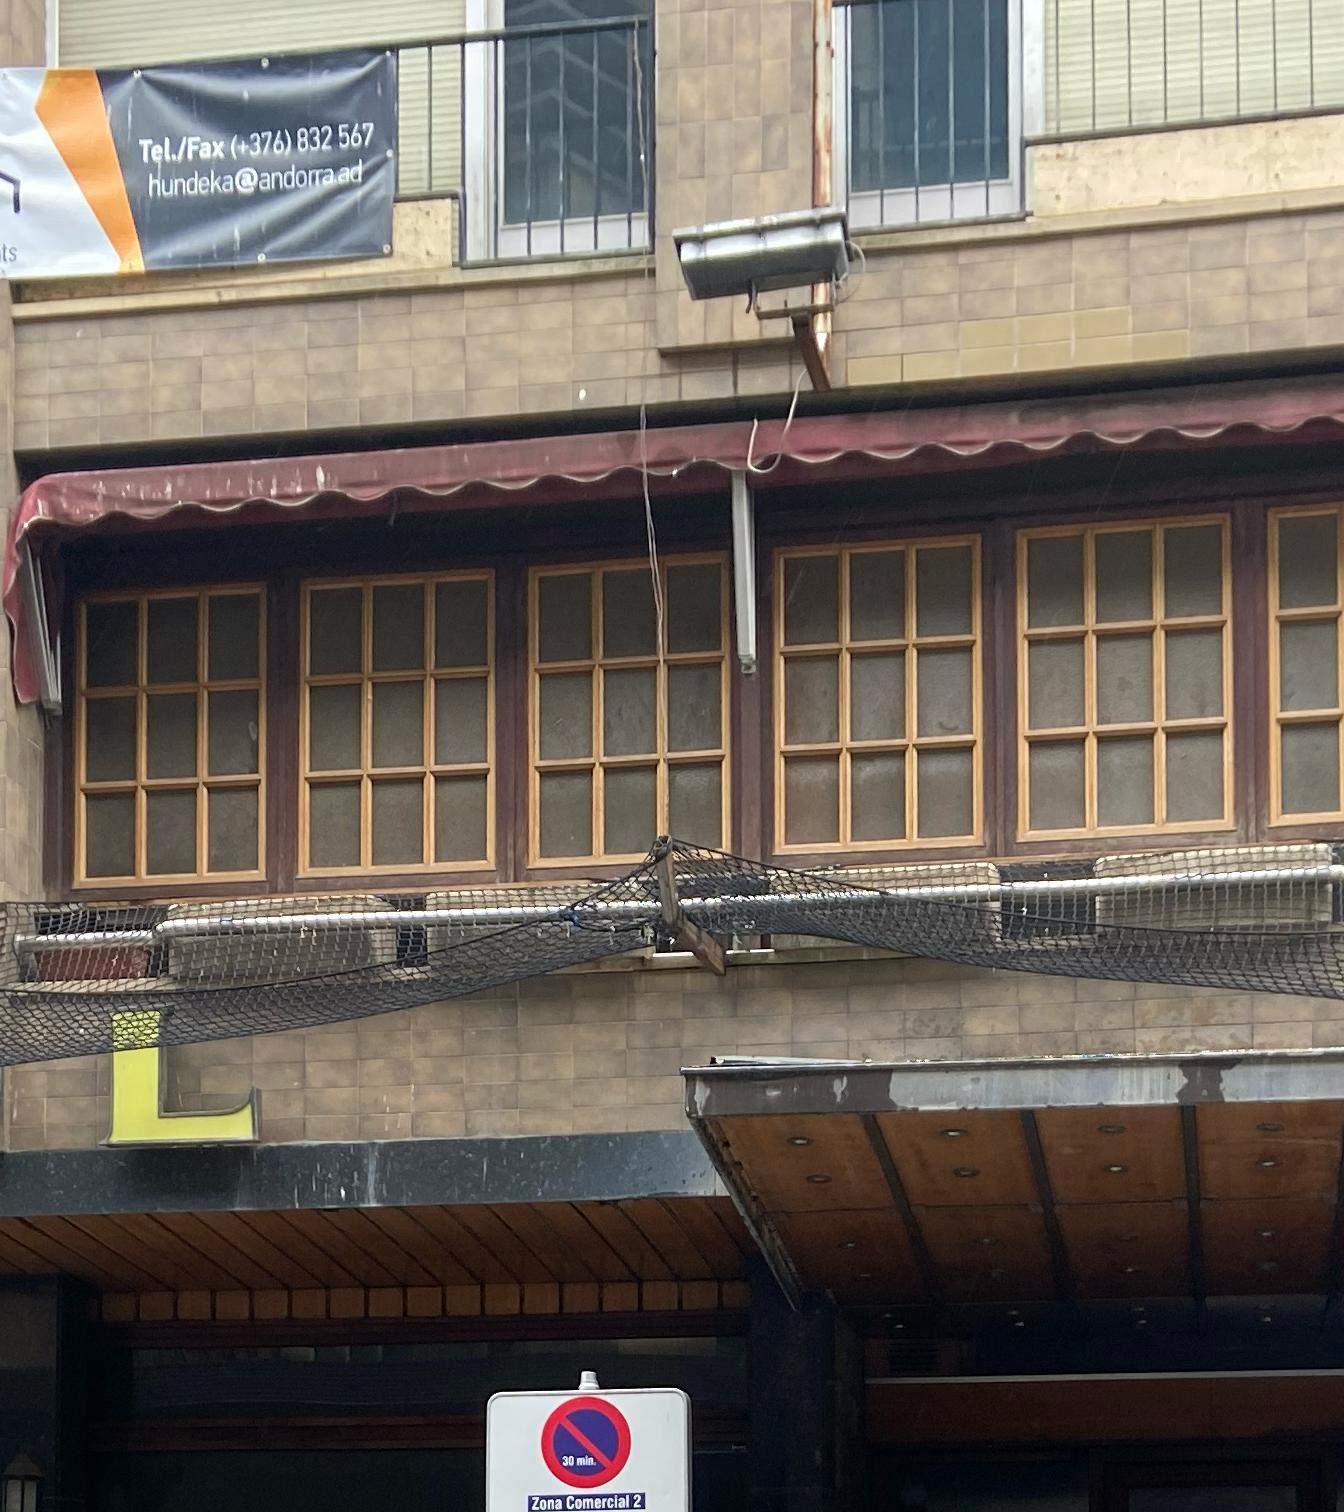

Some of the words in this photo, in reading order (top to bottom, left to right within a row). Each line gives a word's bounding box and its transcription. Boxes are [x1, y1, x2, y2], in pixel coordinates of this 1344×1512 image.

[138, 136, 225, 163] Tel./Fax
[230, 129, 292, 160] (+376)
[296, 125, 333, 152] 832
[338, 122, 375, 148] 567
[148, 158, 363, 198] hundeka@andorra.ad
[562, 1455, 574, 1467] 30
[576, 1455, 597, 1467] min.
[531, 1496, 563, 1511] Zona
[566, 1494, 630, 1510] Comercial
[633, 1494, 642, 1508] 2
